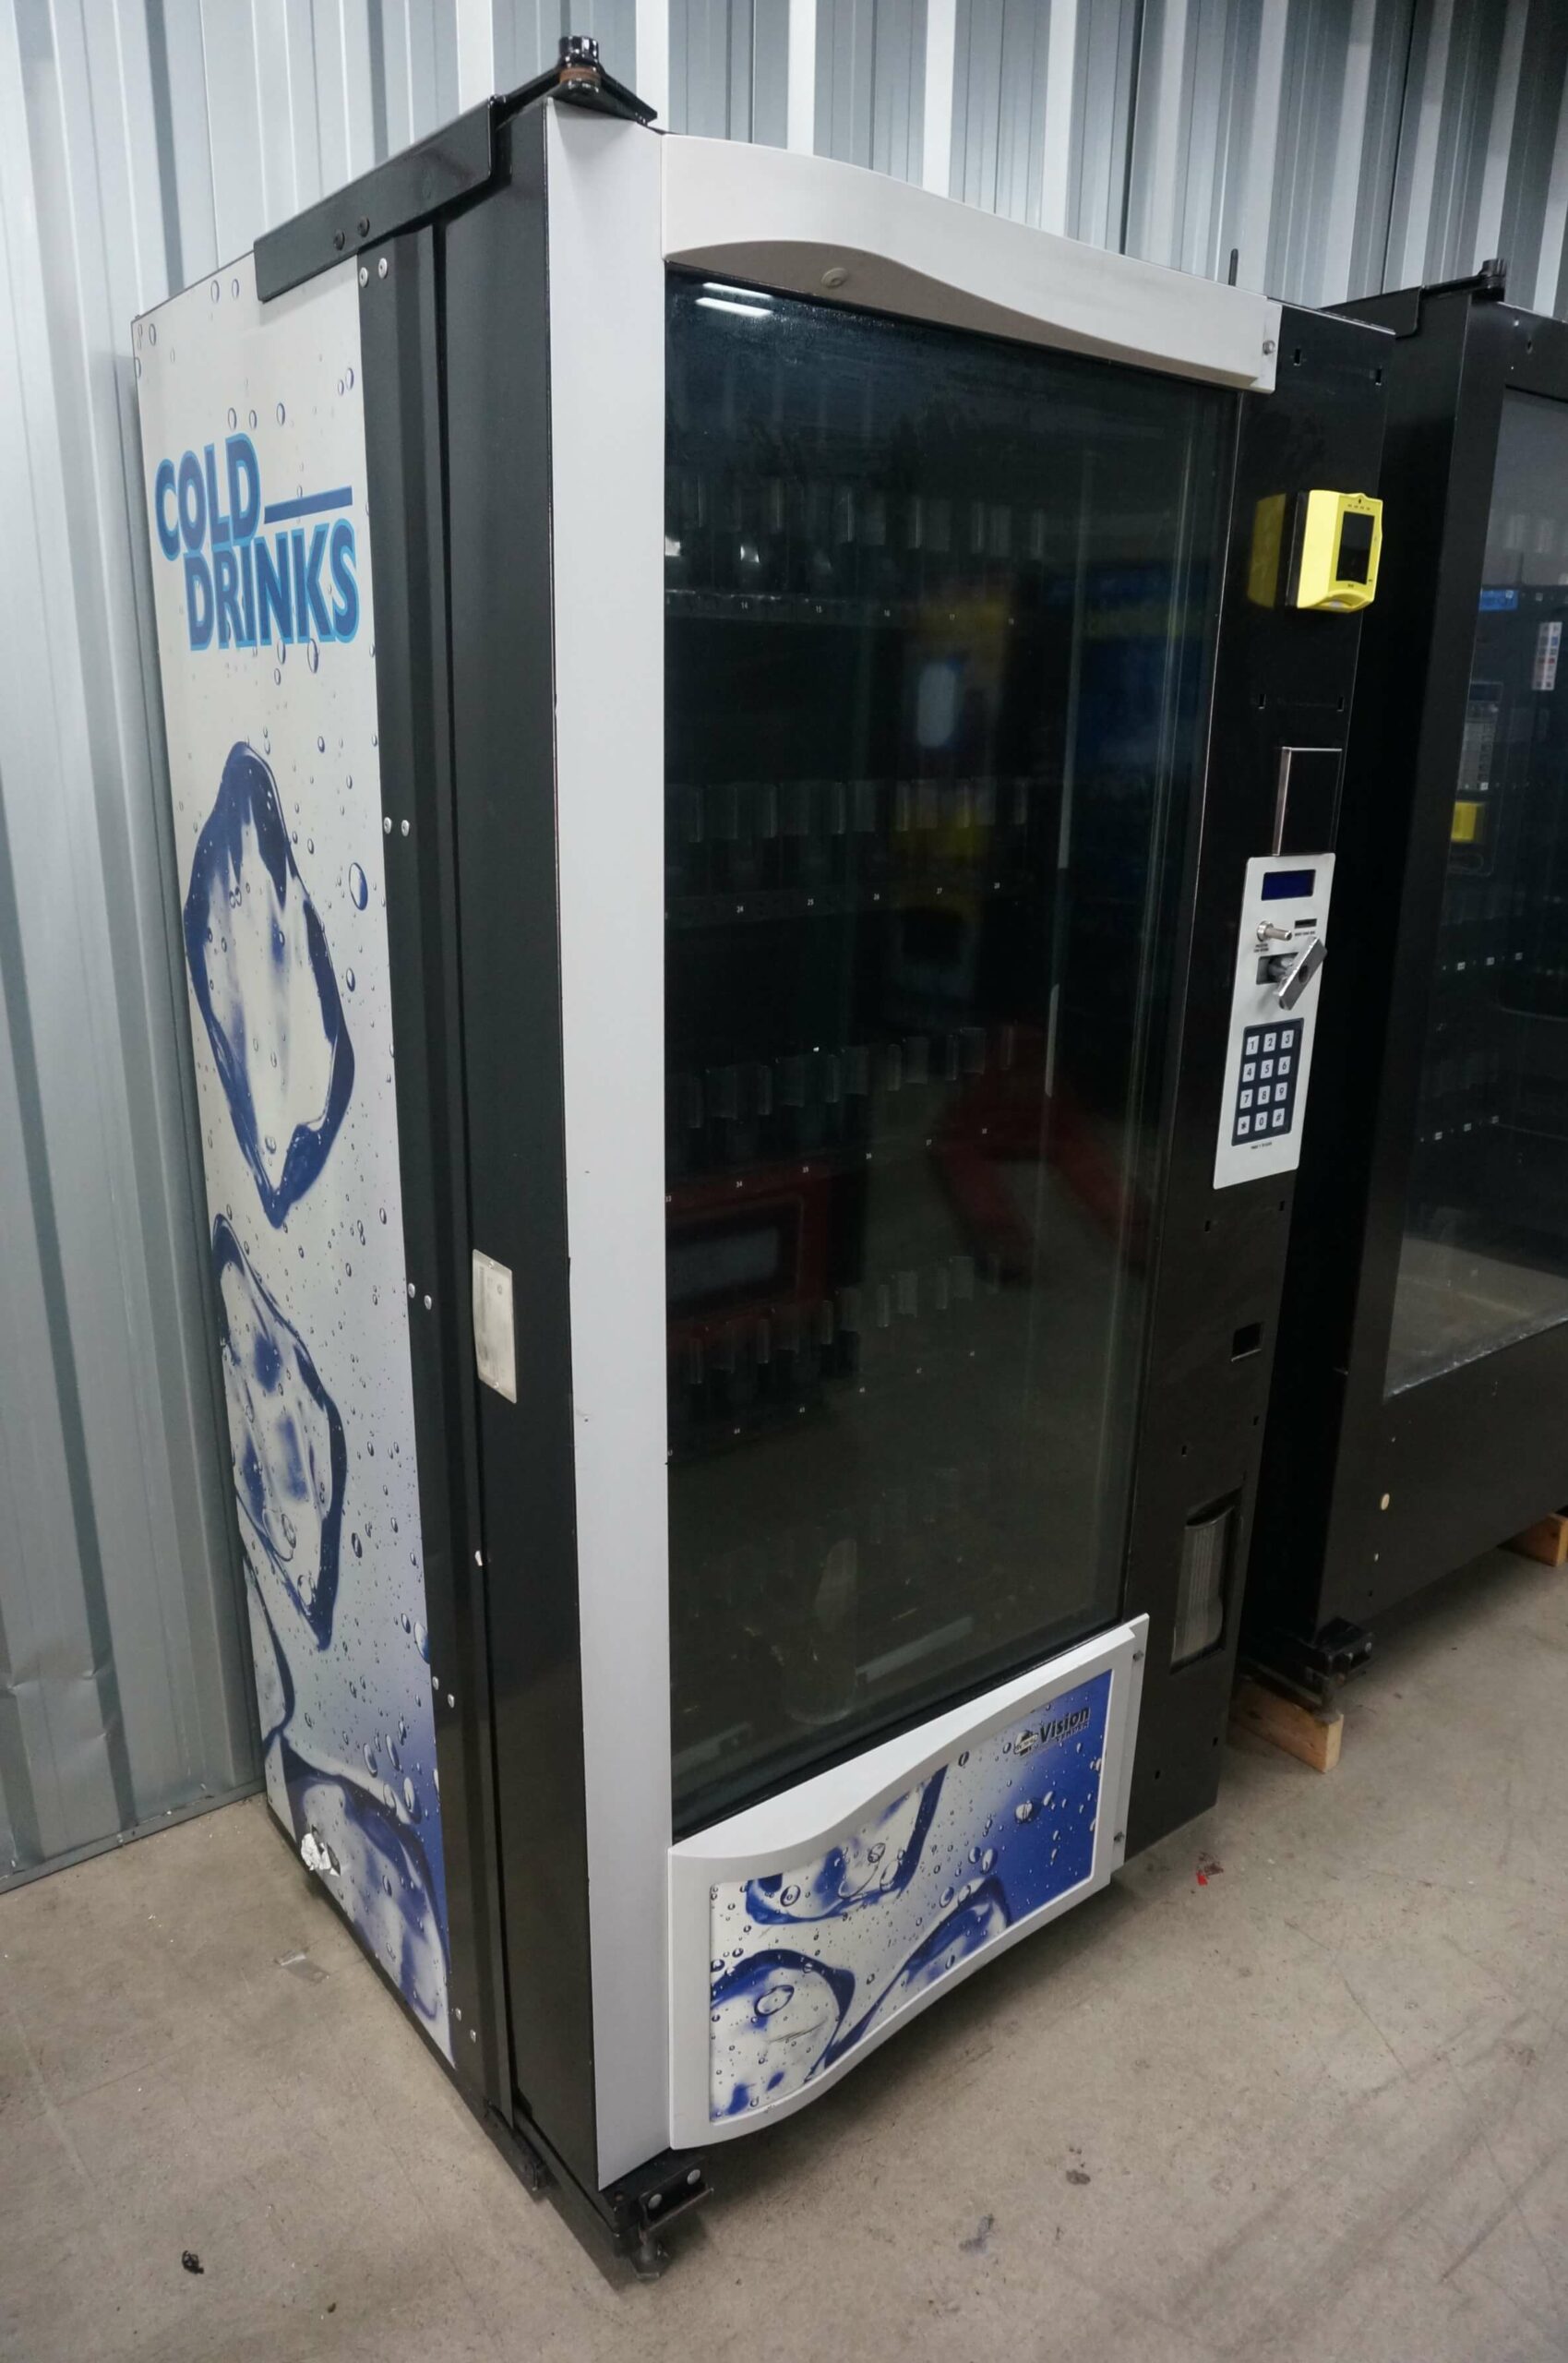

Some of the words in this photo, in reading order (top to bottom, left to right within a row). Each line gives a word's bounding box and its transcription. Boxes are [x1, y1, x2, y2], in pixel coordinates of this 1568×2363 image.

[155, 432, 260, 561] COLD
[183, 518, 359, 651] DRINKS
[1040, 1707, 1090, 1743] Vision
